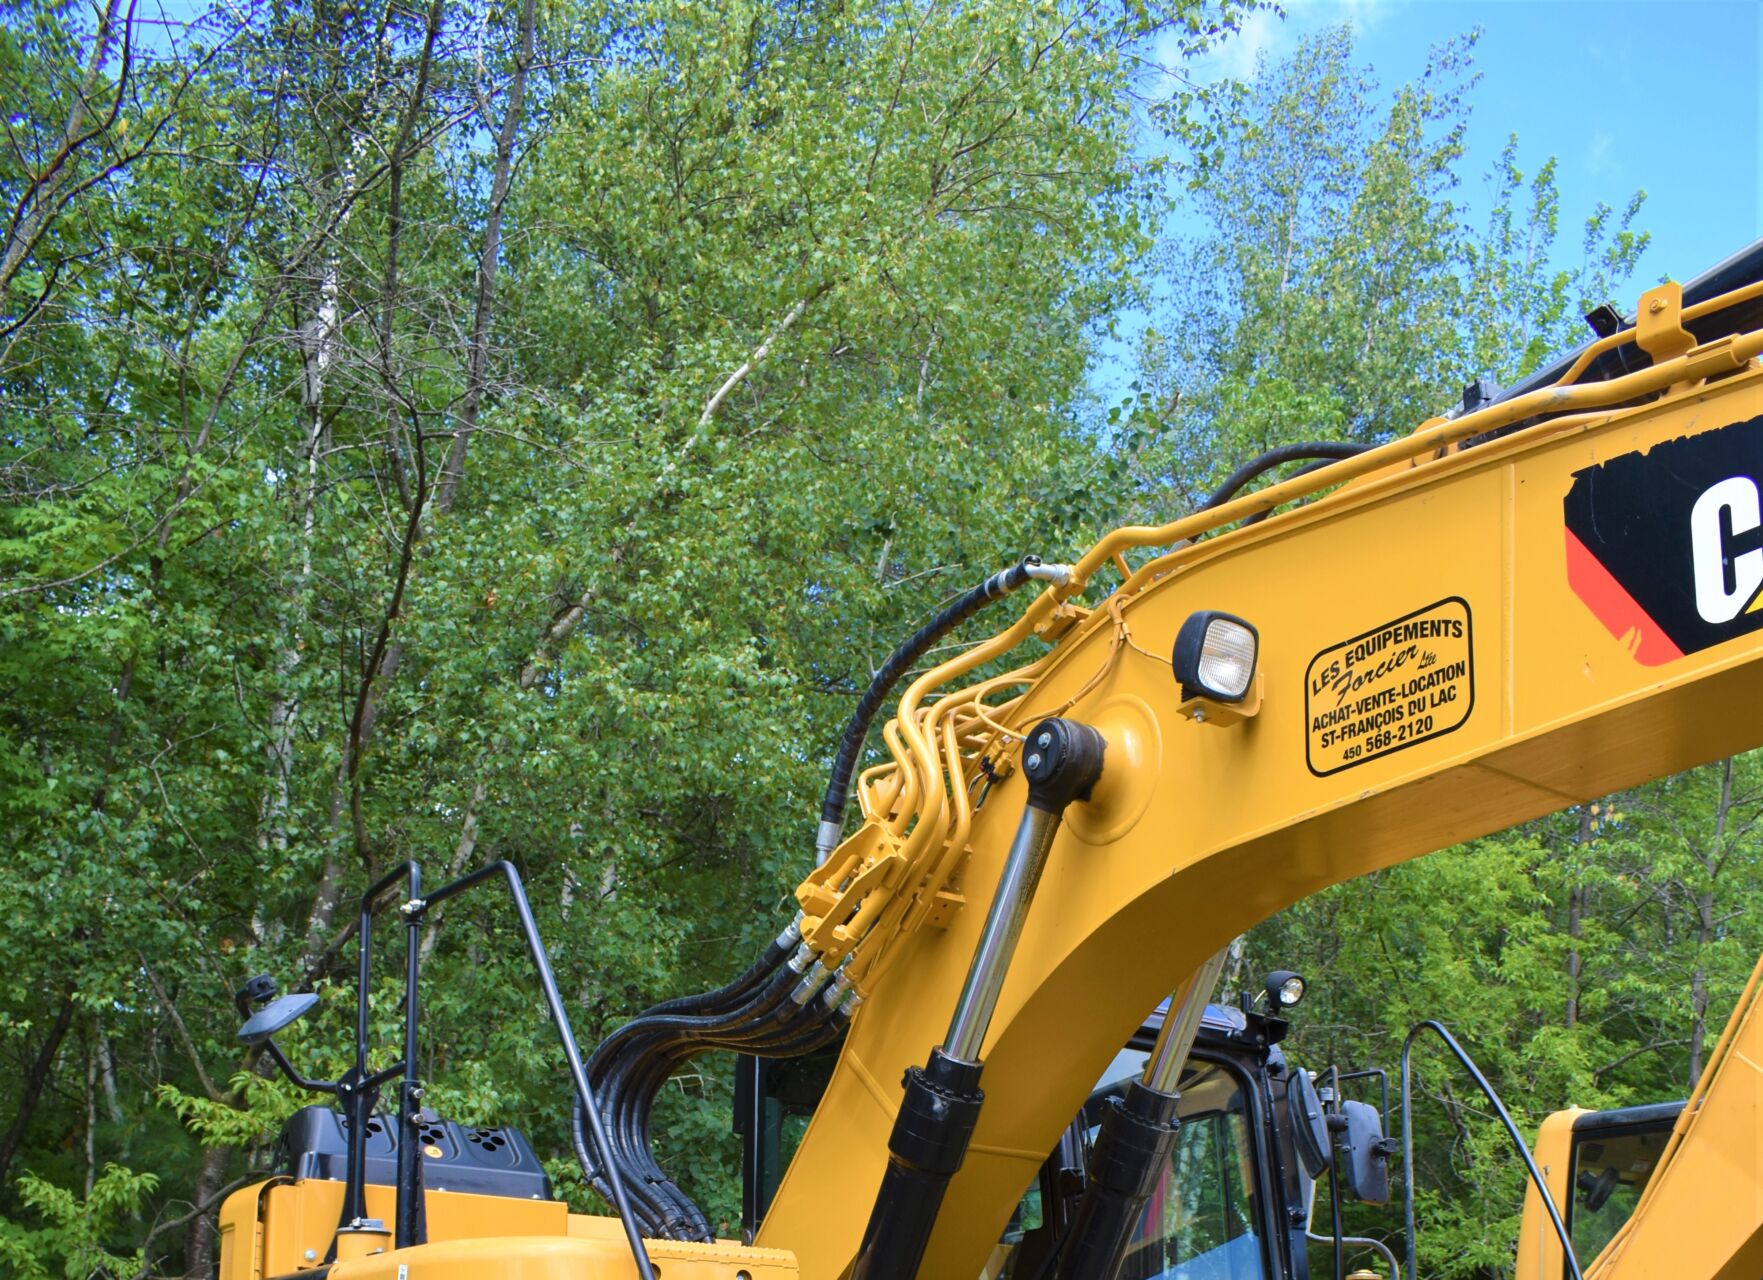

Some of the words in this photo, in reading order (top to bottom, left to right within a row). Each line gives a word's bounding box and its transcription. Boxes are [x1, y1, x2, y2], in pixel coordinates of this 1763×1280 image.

[1313, 660, 1340, 696] LES
[1345, 619, 1463, 669] EQUIPEMENTS
[1331, 644, 1419, 706] Forcier
[1312, 660, 1465, 733] ACHAT-VENTE-LOCATION
[1321, 705, 1404, 749] ST-FRANÇOIS
[1408, 695, 1426, 716] DU
[1430, 685, 1457, 708] LAC
[1343, 745, 1362, 760] 450
[1366, 715, 1433, 753] 568-2120
